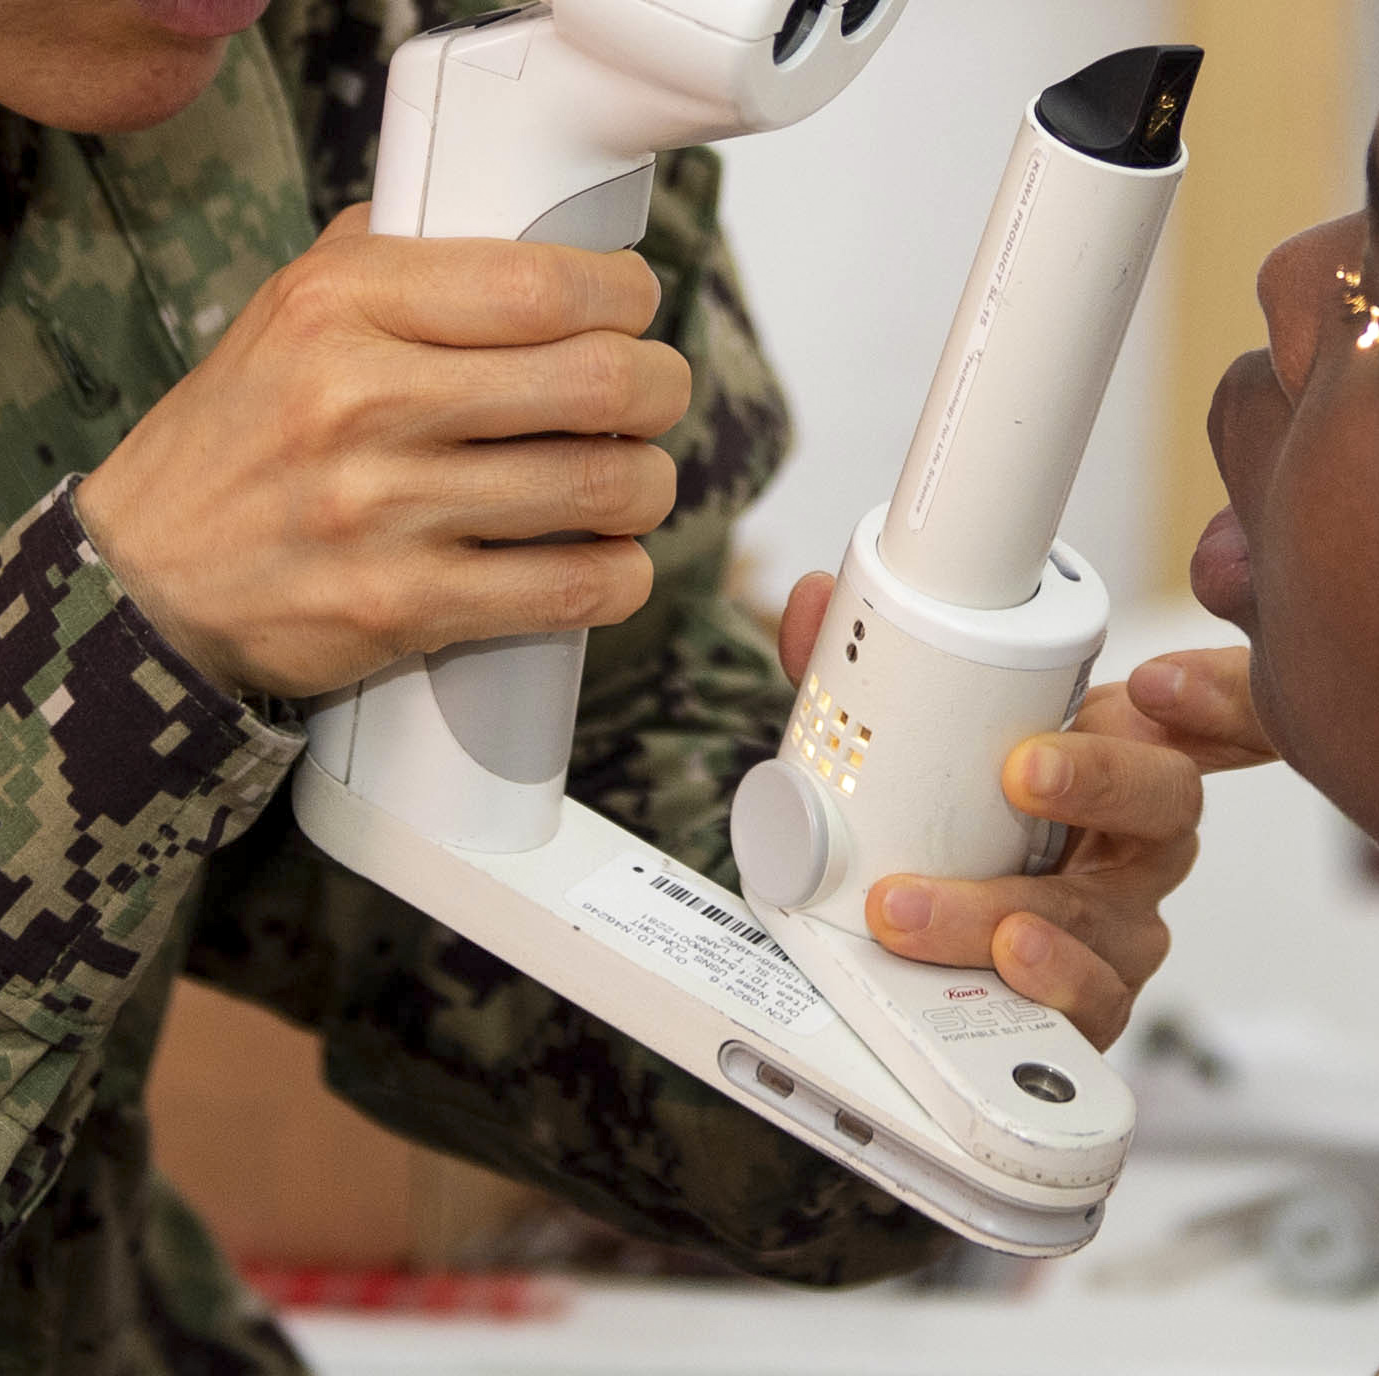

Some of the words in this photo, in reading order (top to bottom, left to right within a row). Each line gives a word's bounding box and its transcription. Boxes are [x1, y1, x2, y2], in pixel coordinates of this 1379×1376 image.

[1020, 159, 1040, 207] KOWA
[995, 209, 1023, 284] PRODUCT
[628, 917, 689, 954] COMFORT
[693, 931, 730, 954] LAMP
[659, 946, 690, 966] Org
[692, 953, 730, 976] USNS
[947, 987, 988, 1000] Kowa
[772, 998, 803, 1018] Org
[942, 1029, 999, 1042] PORTABLE
[1028, 1021, 1057, 1033] LAMP
